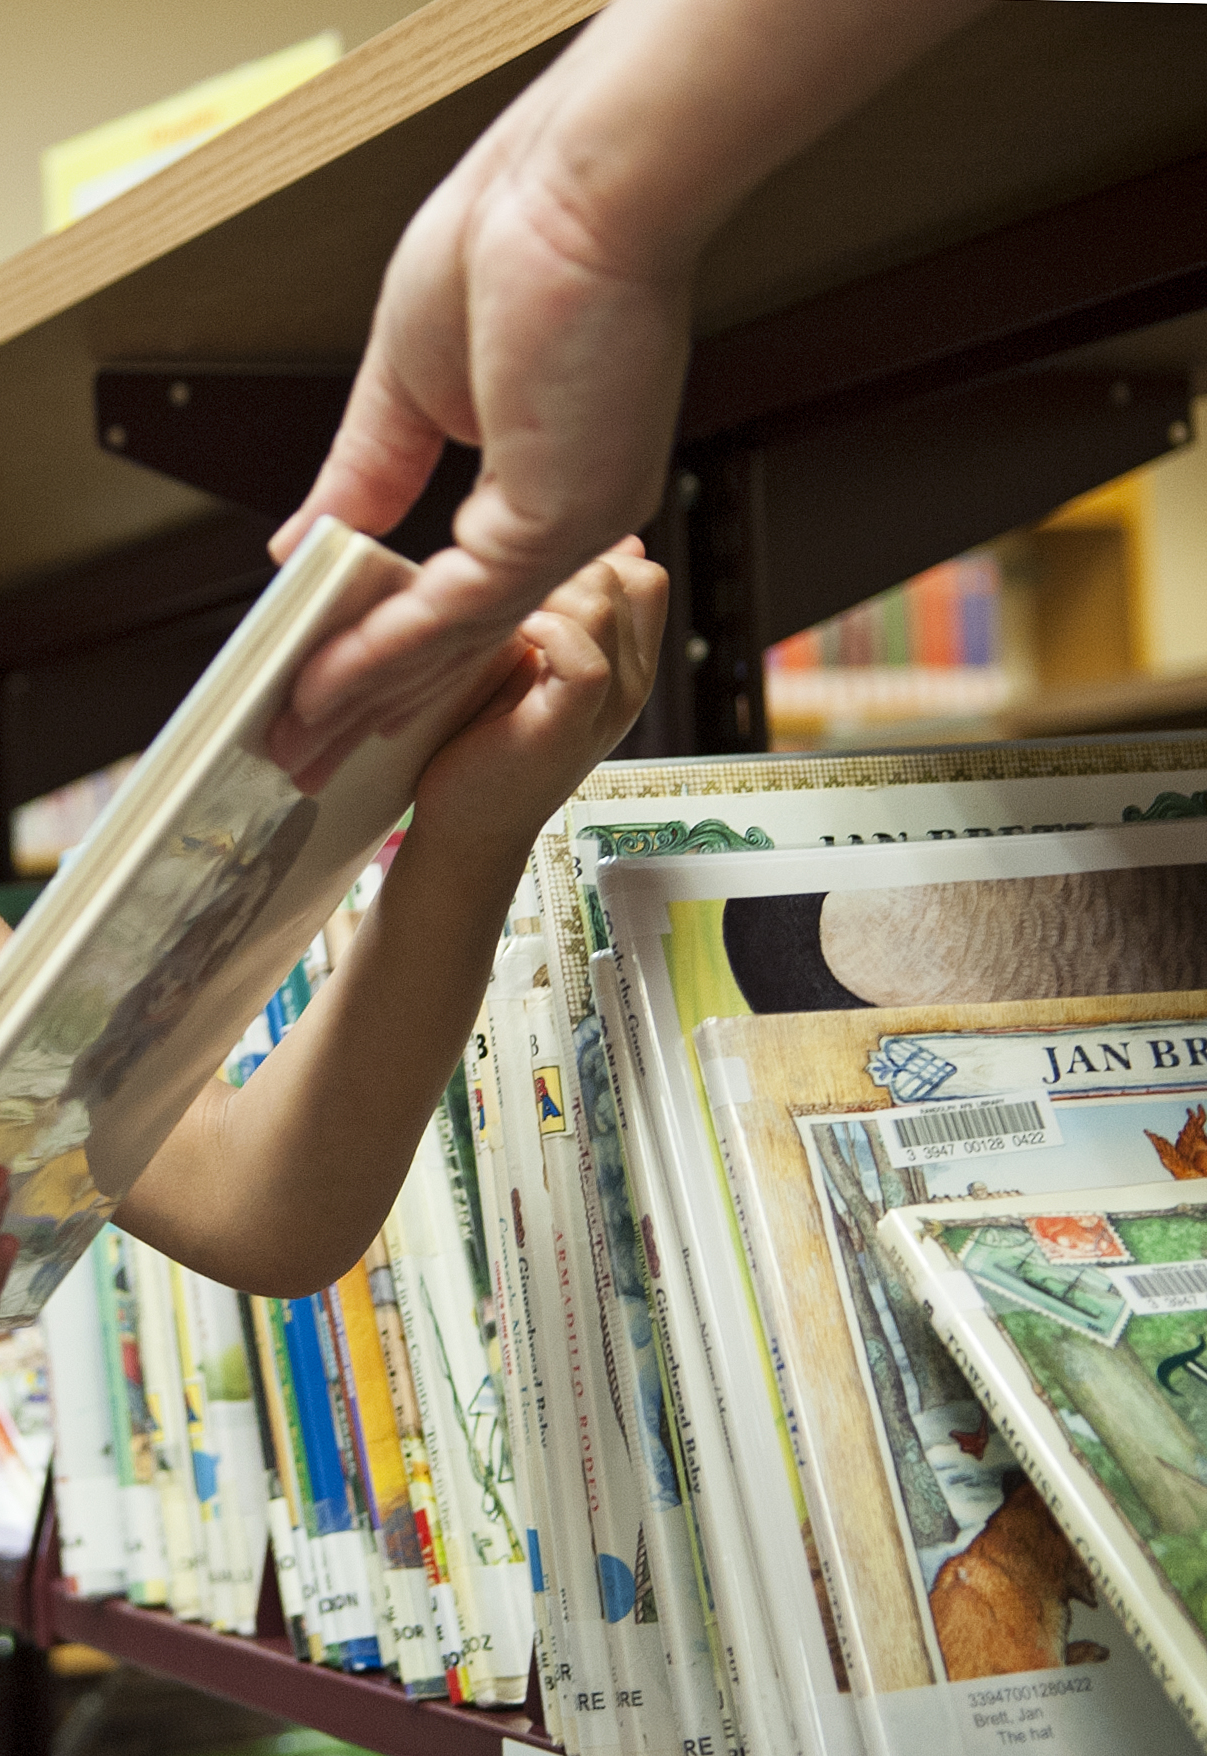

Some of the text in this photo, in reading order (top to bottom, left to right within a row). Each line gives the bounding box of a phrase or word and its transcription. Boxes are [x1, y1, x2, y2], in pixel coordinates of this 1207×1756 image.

[620, 974, 632, 1011] the
[627, 1014, 646, 1076] Goose
[1042, 1041, 1132, 1085] JAN
[611, 1071, 628, 1131] BRETT
[906, 1131, 1046, 1162] 3 3947 00128 0422
[518, 1256, 549, 1449] Gingerbread Baby
[556, 1231, 600, 1512] ARMADILLO RODEO
[656, 1287, 702, 1495] Gingerbread Baby
[770, 1338, 806, 1468] The Hat
[945, 1328, 999, 1412] TOWN
[999, 1416, 1064, 1511] MOUSE
[966, 1676, 1093, 1708] 33947001280422
[1017, 1706, 1044, 1723] Jan
[996, 1725, 1055, 1746] The hat
